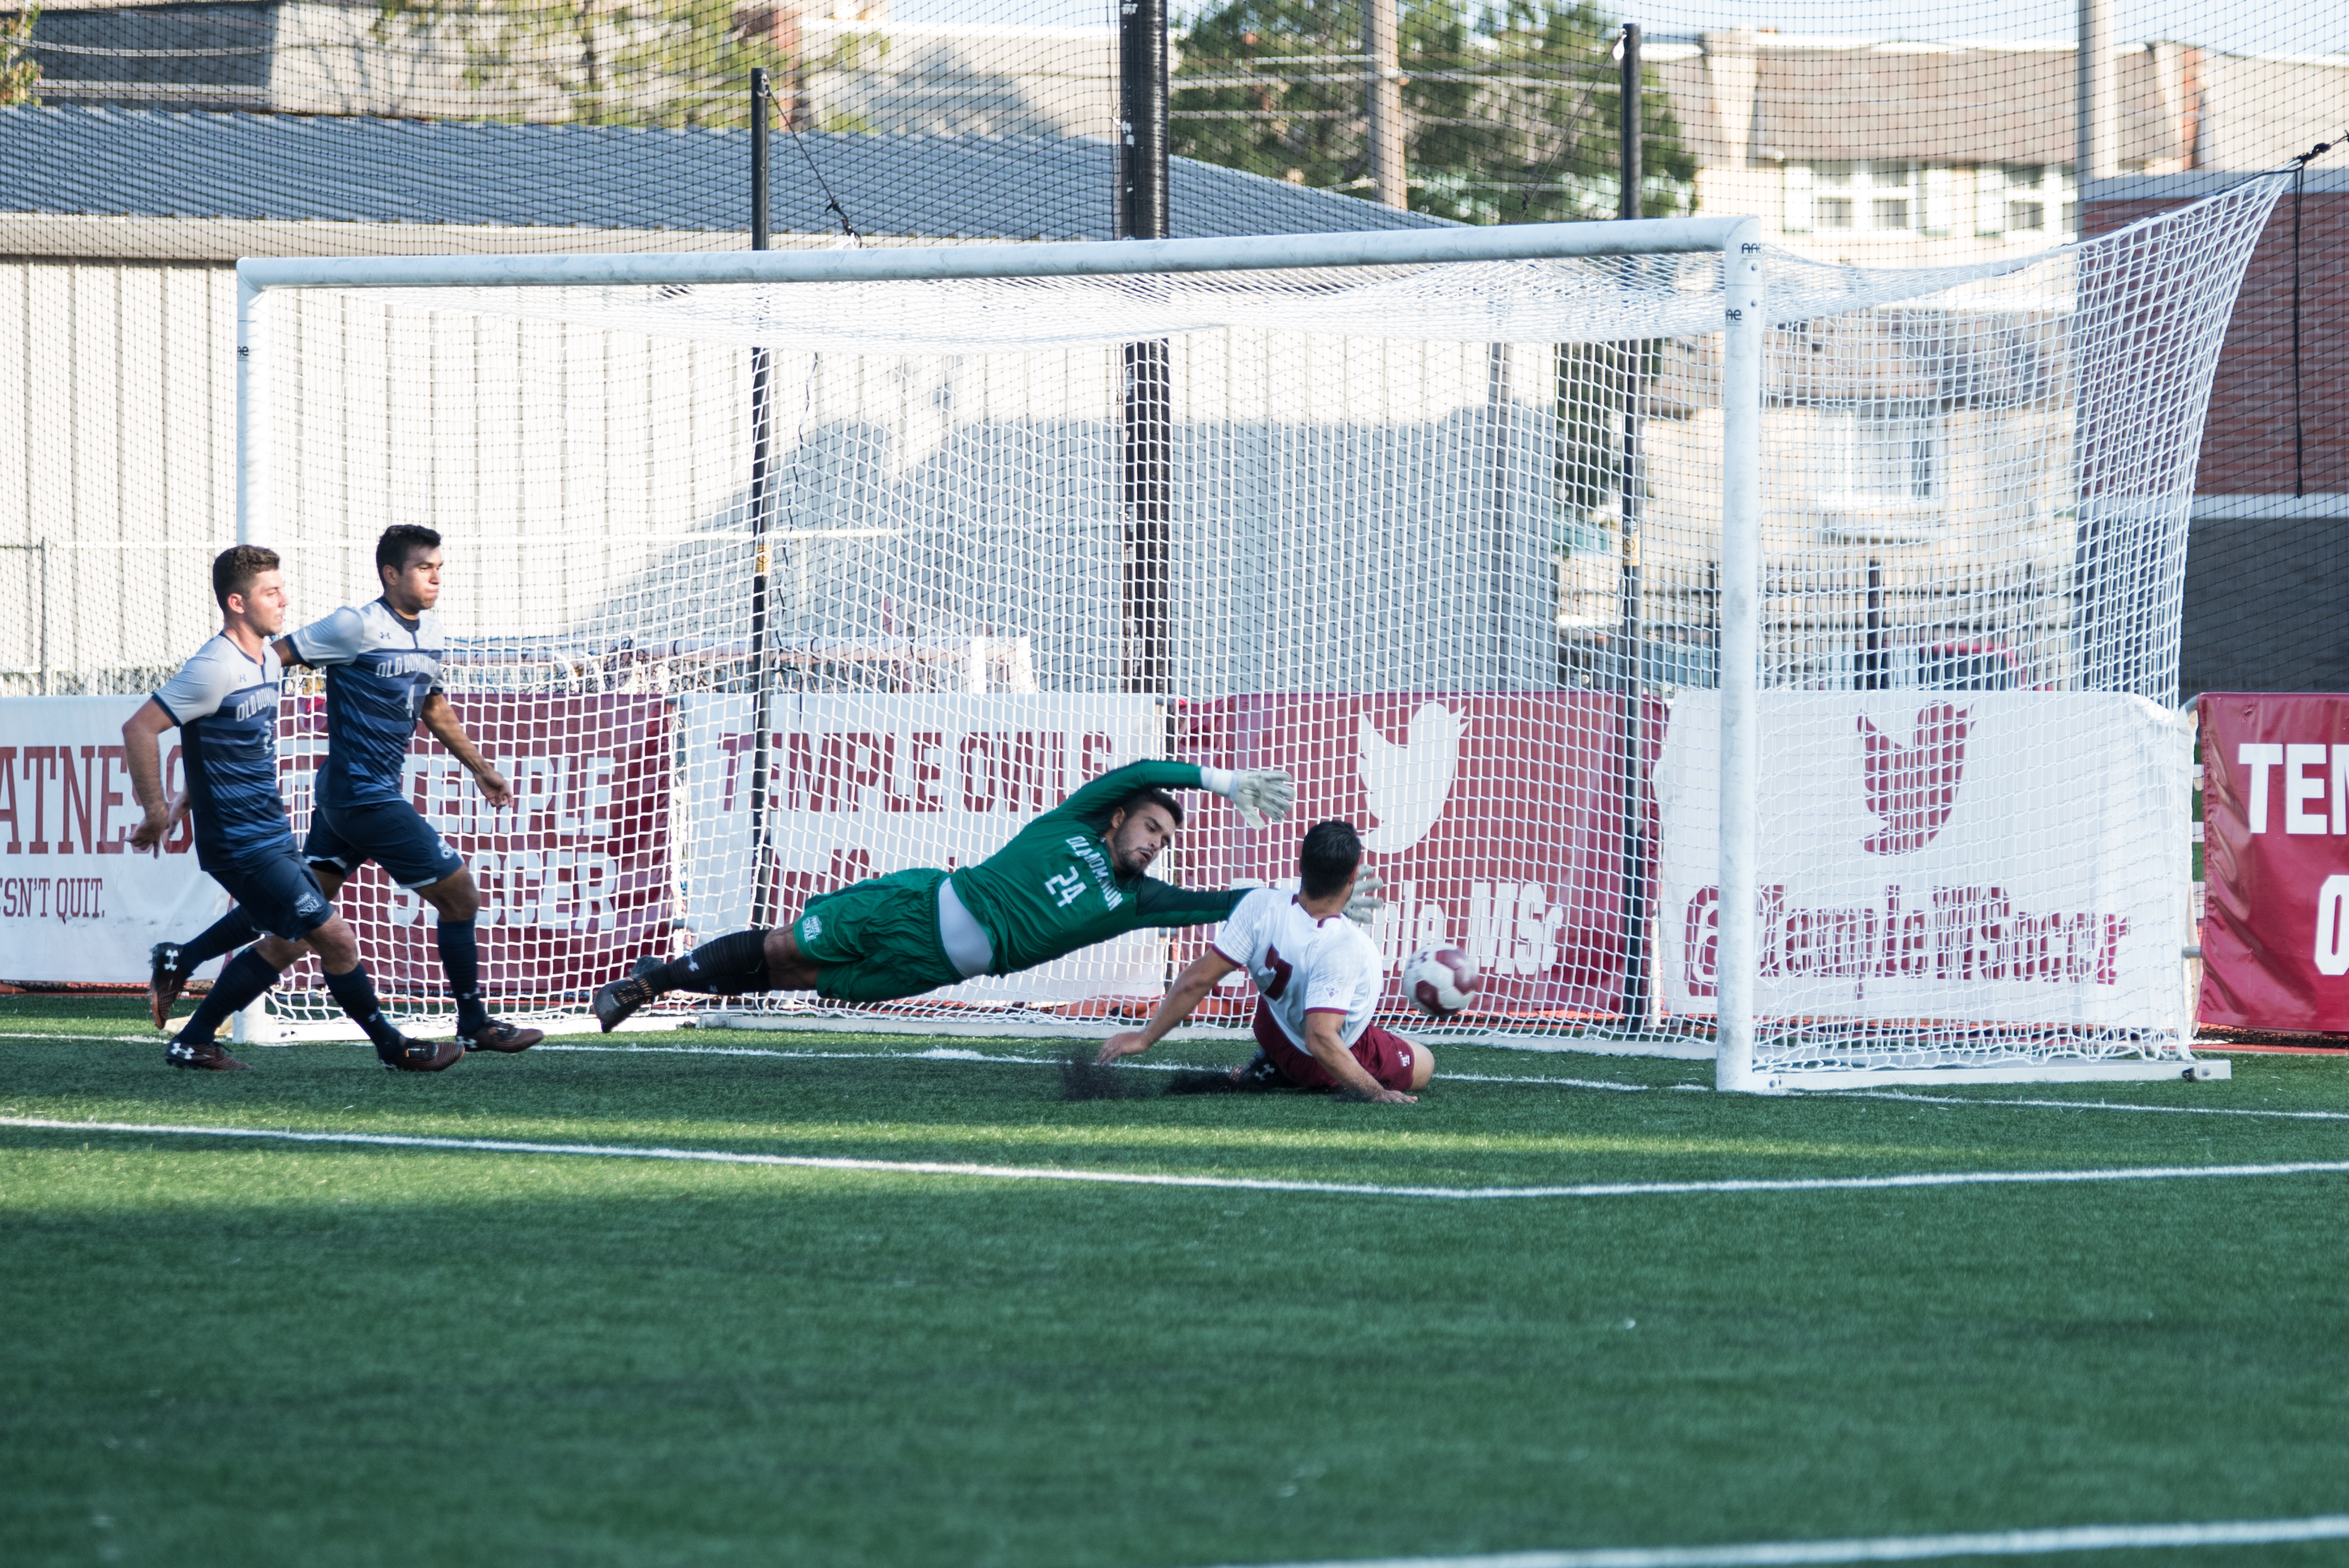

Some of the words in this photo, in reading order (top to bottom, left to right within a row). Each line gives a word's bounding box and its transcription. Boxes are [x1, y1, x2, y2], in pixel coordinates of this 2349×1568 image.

[376, 656, 403, 678] OLD
[236, 694, 258, 722] OLD
[402, 754, 616, 836] TEMPLE
[718, 732, 944, 812] TEMPLE
[0, 745, 194, 854] ATNES
[56, 878, 105, 925] QUIT.
[1044, 865, 1087, 908] 24
